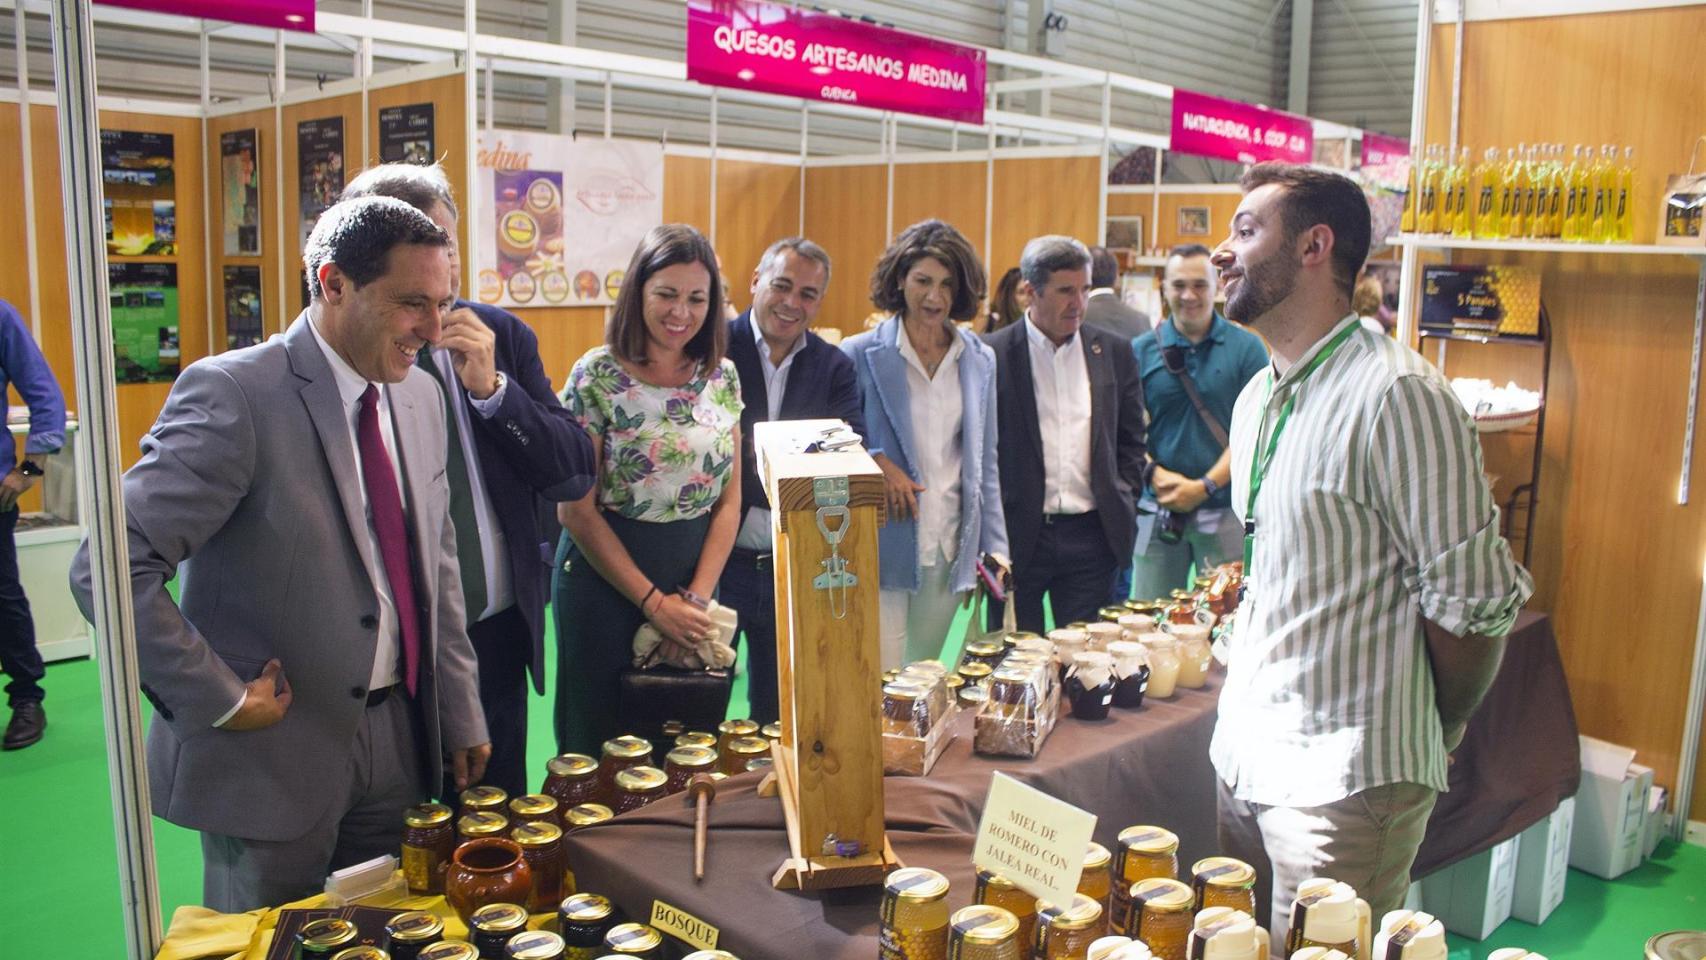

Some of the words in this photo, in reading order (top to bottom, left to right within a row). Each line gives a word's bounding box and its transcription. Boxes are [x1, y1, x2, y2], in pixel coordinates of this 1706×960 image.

[713, 26, 797, 60] QUESOS
[801, 43, 904, 80] ARTESANOS
[907, 63, 968, 92] MEDINA
[821, 85, 858, 102] CUENCA
[477, 140, 533, 171] edina
[1008, 809, 1038, 834] MIEL
[1040, 825, 1058, 843] DE
[985, 844, 1021, 872] JALEA
[988, 823, 1039, 857] ROMERO
[1042, 849, 1068, 871] CON
[655, 905, 715, 946] BOSQUE
